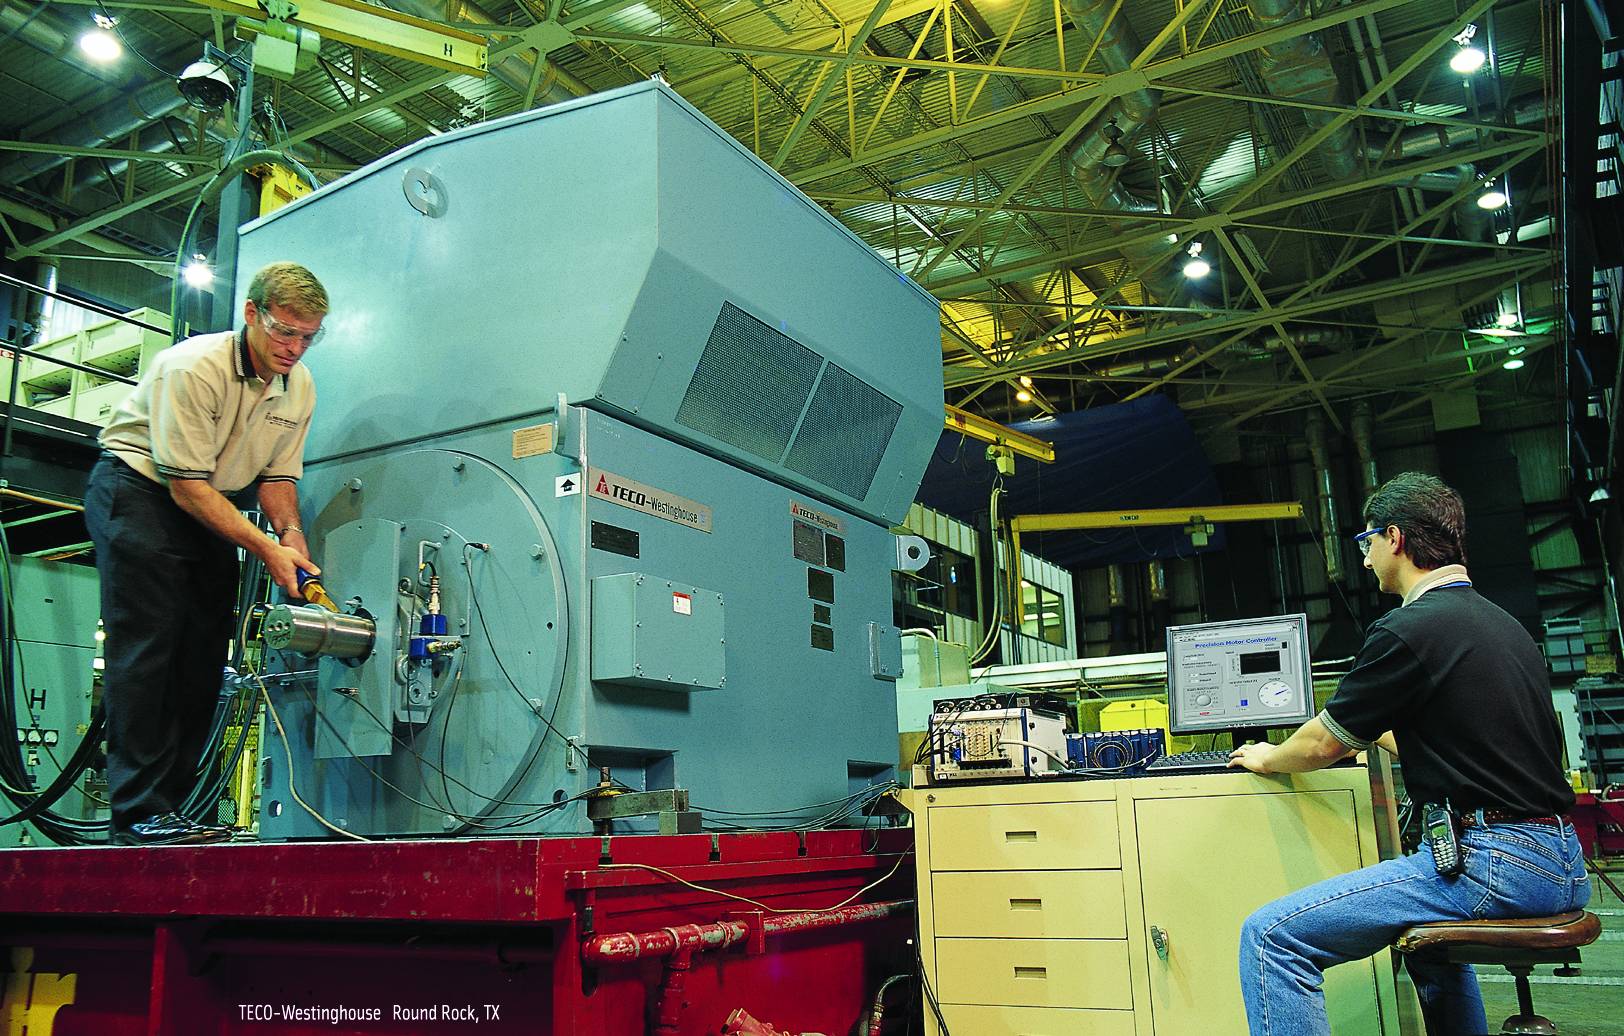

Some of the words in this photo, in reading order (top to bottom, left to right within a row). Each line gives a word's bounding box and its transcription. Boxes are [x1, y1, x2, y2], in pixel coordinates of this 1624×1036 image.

[444, 43, 453, 57] H
[613, 484, 698, 524] TECO-Westinghouse
[1195, 641, 1225, 649] Precision
[30, 688, 47, 710] H
